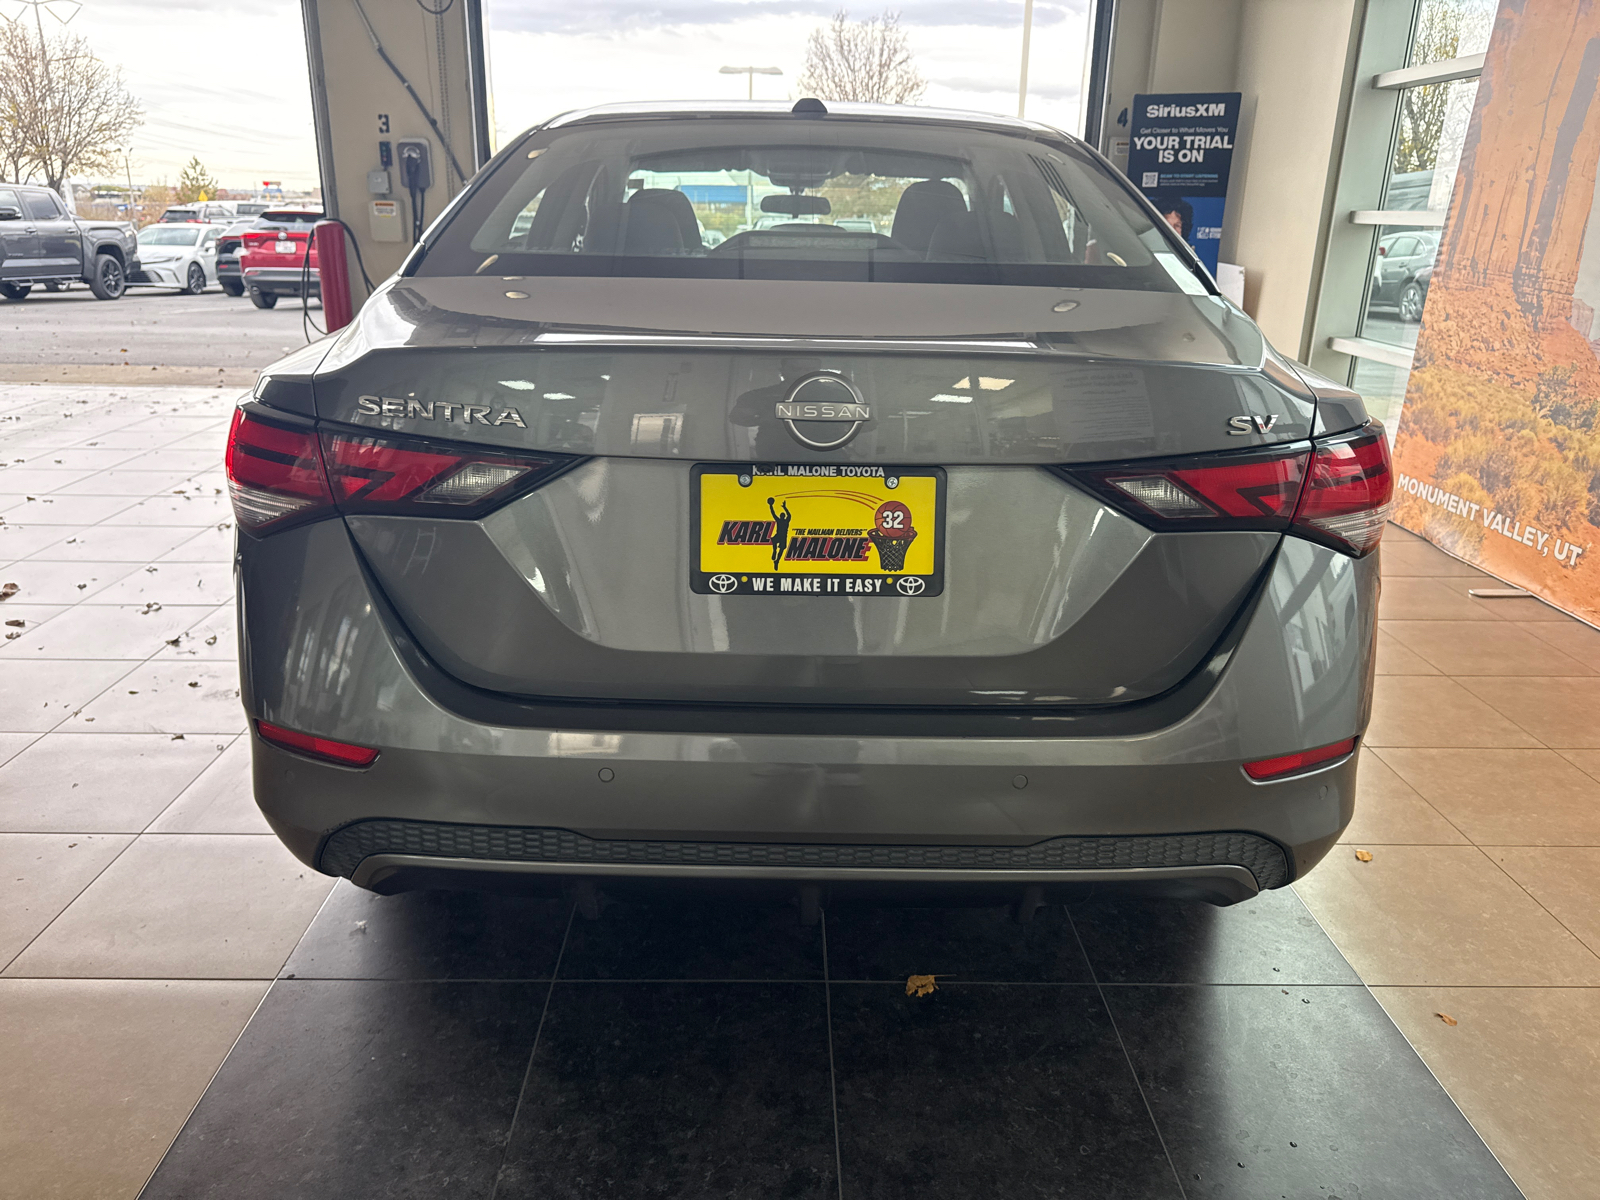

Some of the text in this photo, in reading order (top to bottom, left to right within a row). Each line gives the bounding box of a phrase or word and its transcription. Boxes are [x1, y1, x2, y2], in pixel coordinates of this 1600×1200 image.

[1117, 107, 1128, 128] 4
[1146, 103, 1226, 118] SiriusXM
[378, 113, 391, 133] 3
[1133, 135, 1180, 150] YOUR
[1183, 135, 1233, 149] TRIAL
[1158, 149, 1205, 163] IS ON
[358, 395, 528, 429] SENTRA
[778, 405, 870, 419] NISSAN
[1227, 414, 1279, 436] SV
[787, 465, 837, 477] MALONE
[840, 466, 885, 477] TOYOTA
[882, 510, 904, 529] 32
[1397, 473, 1583, 566] MONUMENT VALLEY, UT
[717, 520, 775, 545] KARL
[807, 528, 835, 536] MAILMAN
[785, 537, 870, 561] MALONE
[752, 577, 883, 593] WE MAKE IT EASY
